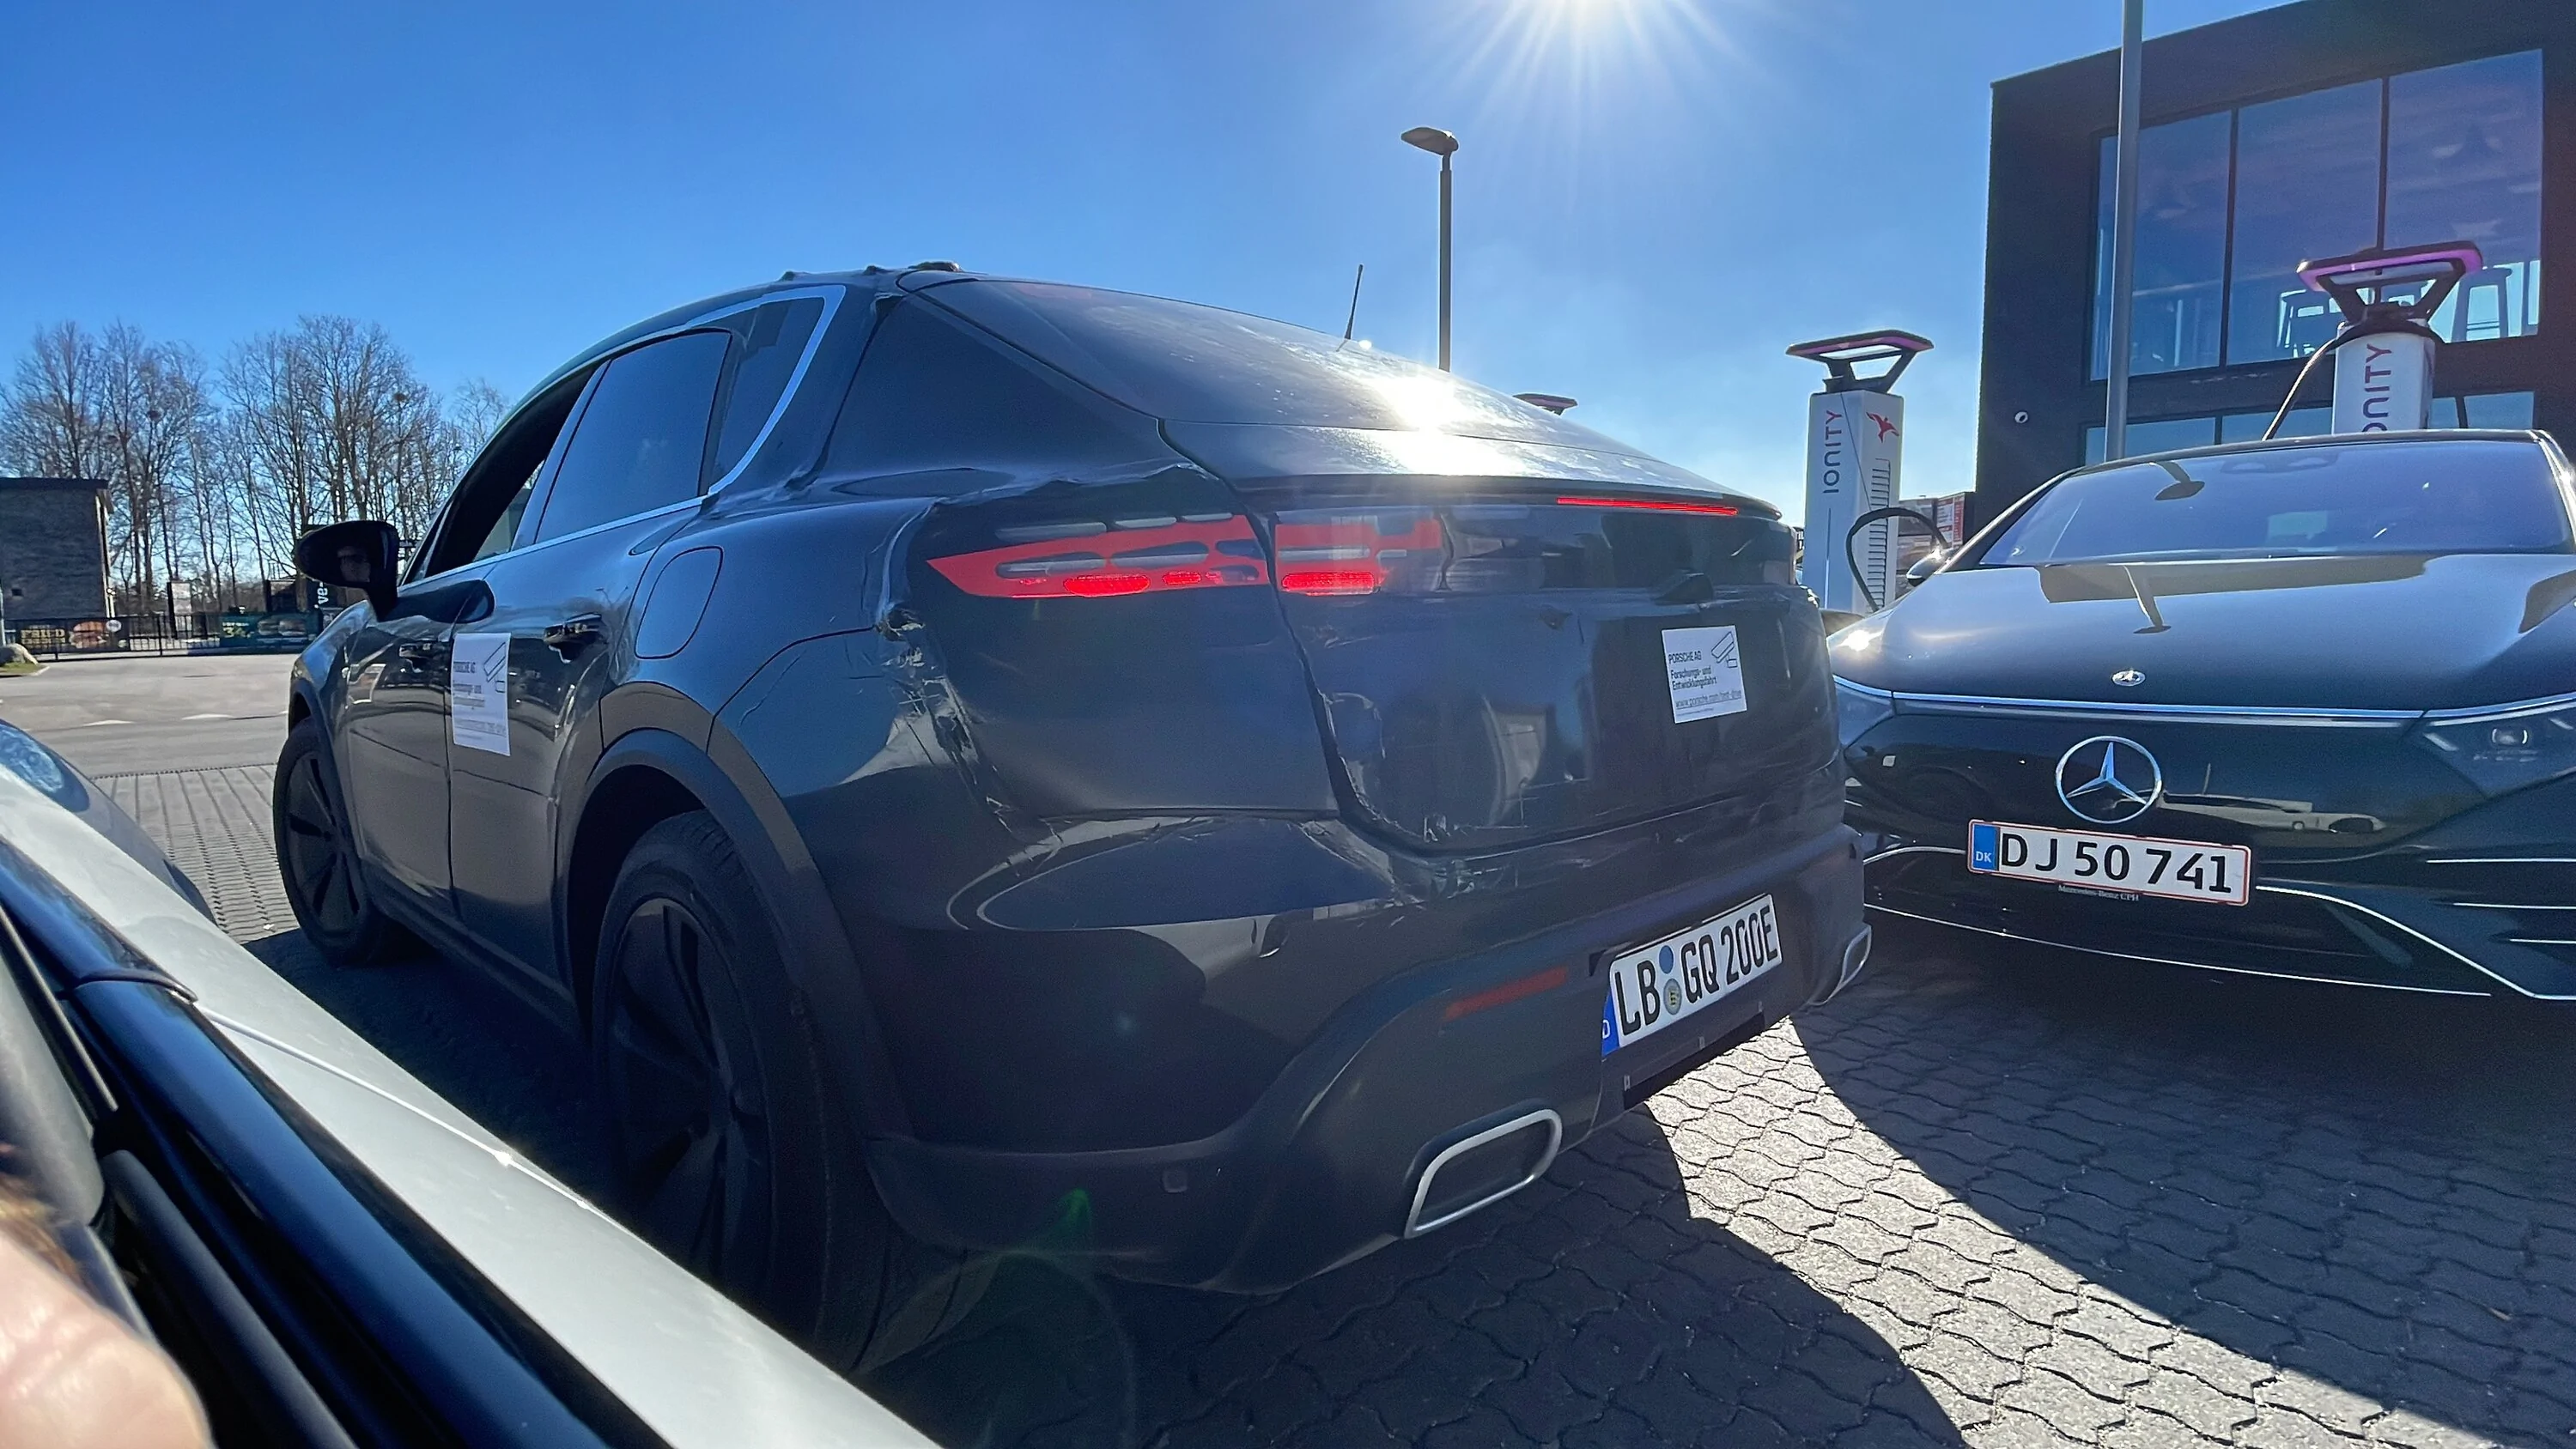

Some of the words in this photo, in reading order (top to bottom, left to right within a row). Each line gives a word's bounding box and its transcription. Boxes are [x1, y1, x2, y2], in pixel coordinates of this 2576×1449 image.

[2361, 343, 2392, 433] NITY
[1822, 409, 1844, 494] IONITY
[1976, 851, 1992, 863] DK
[2001, 833, 2058, 872] DJ
[2074, 841, 2130, 881] 50
[2146, 848, 2232, 894] 741
[1614, 960, 1661, 1036] LB
[1680, 934, 1720, 1004] GQ
[1721, 905, 1778, 985] 200E
